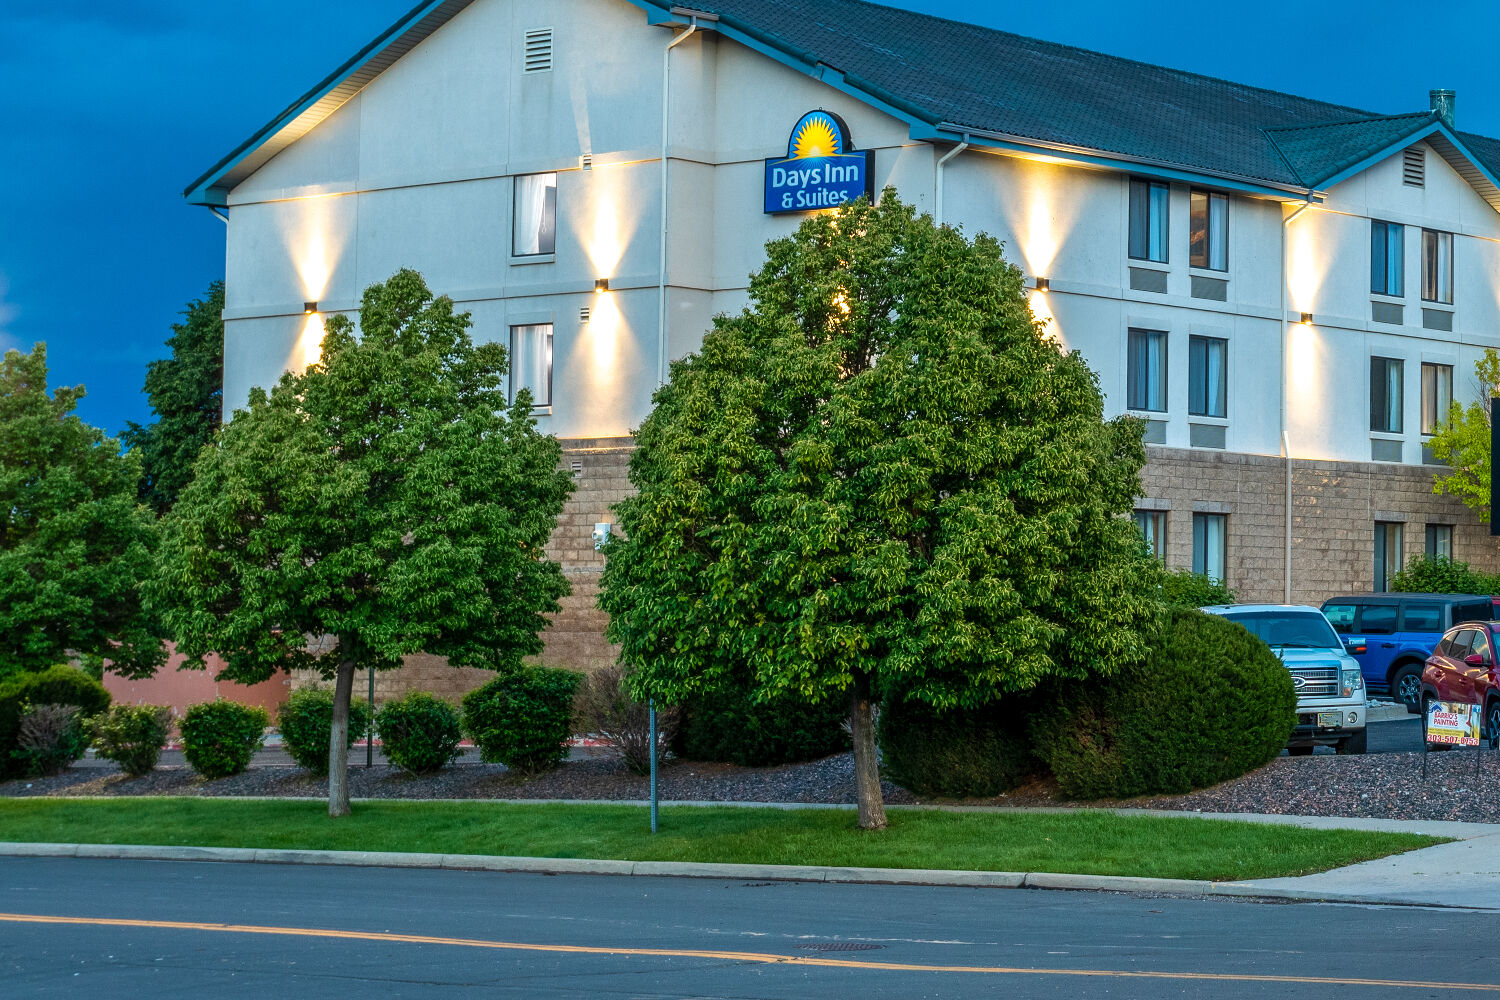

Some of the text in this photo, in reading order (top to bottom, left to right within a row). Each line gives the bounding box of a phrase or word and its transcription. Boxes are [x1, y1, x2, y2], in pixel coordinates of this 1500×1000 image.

[772, 163, 859, 188] Days Inn
[781, 187, 848, 208] & Suites
